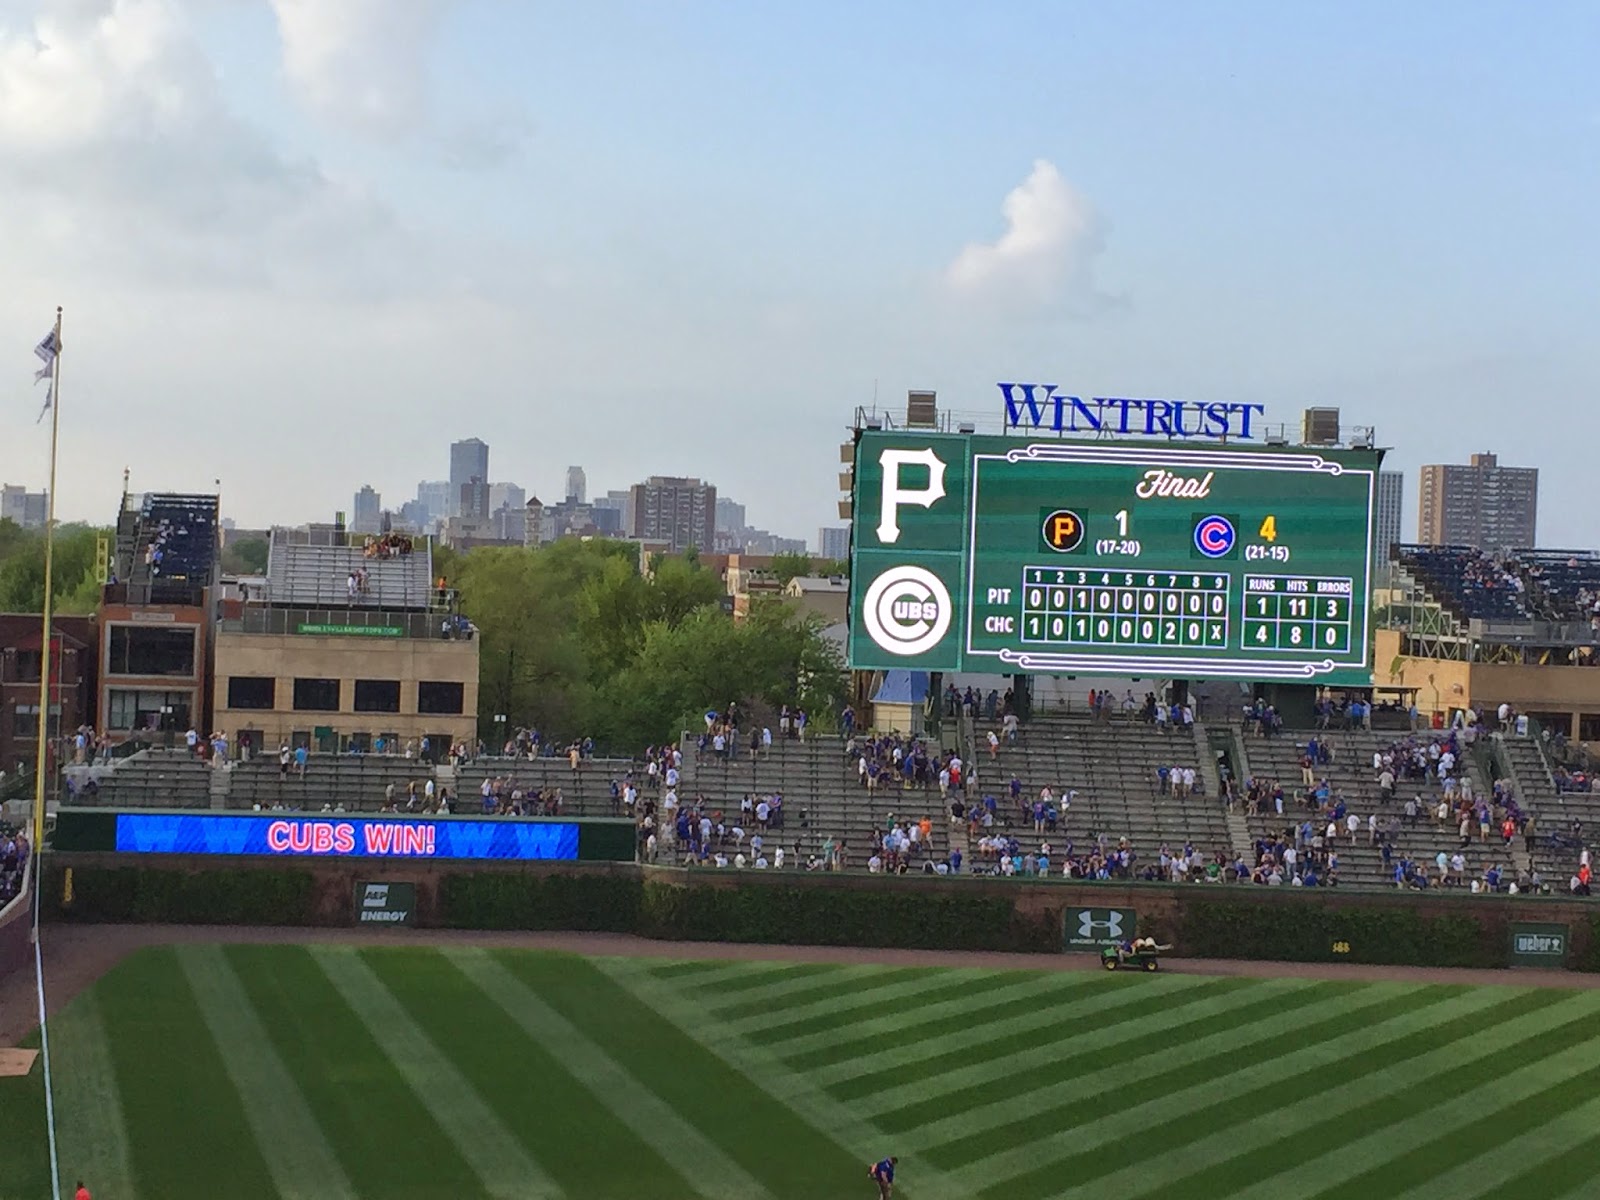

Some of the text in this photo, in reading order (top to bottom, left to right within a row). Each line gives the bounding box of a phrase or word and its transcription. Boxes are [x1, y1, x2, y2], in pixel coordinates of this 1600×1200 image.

[997, 383, 1264, 439] WINTRUST
[876, 447, 947, 543] P
[1136, 469, 1214, 499] Final
[1054, 517, 1074, 545] P
[1115, 510, 1127, 536] 1
[1200, 521, 1228, 551] C
[1259, 516, 1276, 542] 4
[1096, 539, 1140, 556] (17-20)
[1245, 545, 1289, 562] (21-15)
[1034, 570, 1223, 588] 1 2 3 4 5 6 7 8 9
[1249, 579, 1350, 593] RUNS HITS ERRORS
[988, 588, 1337, 618] PIT 0 0 1 0 0 0 0 0 0 1 11 3
[985, 616, 1336, 645] CHC 1 0 1 0 0 0 2 0 X 4 8 0
[267, 820, 355, 853] CUBS
[364, 823, 436, 854] WIN!
[515, 824, 563, 858] W
[361, 911, 408, 921] ENERGY
